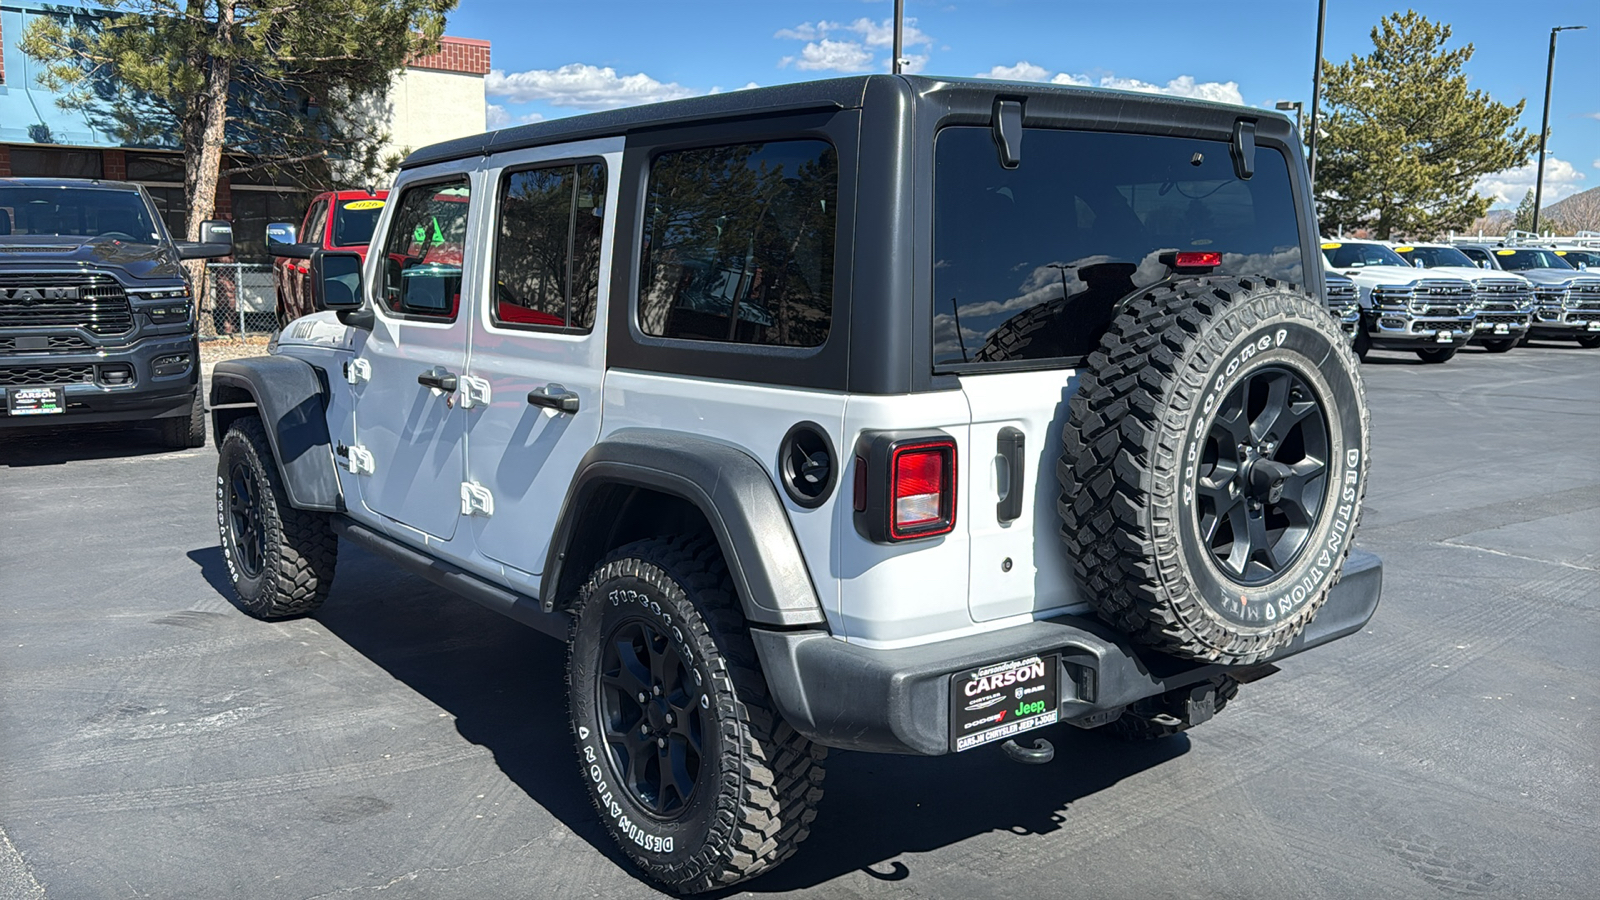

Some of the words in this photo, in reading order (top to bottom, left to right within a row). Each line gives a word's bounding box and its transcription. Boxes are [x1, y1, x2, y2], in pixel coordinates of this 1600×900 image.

[351, 201, 379, 209] 2026
[15, 391, 56, 399] CARSON
[1278, 448, 1360, 614] DESTINATION
[964, 661, 1045, 697] CARSON
[969, 692, 1001, 706] CHRYSLER
[1014, 700, 1045, 717] Jeep
[964, 712, 1002, 730] DODGE
[584, 745, 674, 853] DESTINATION
